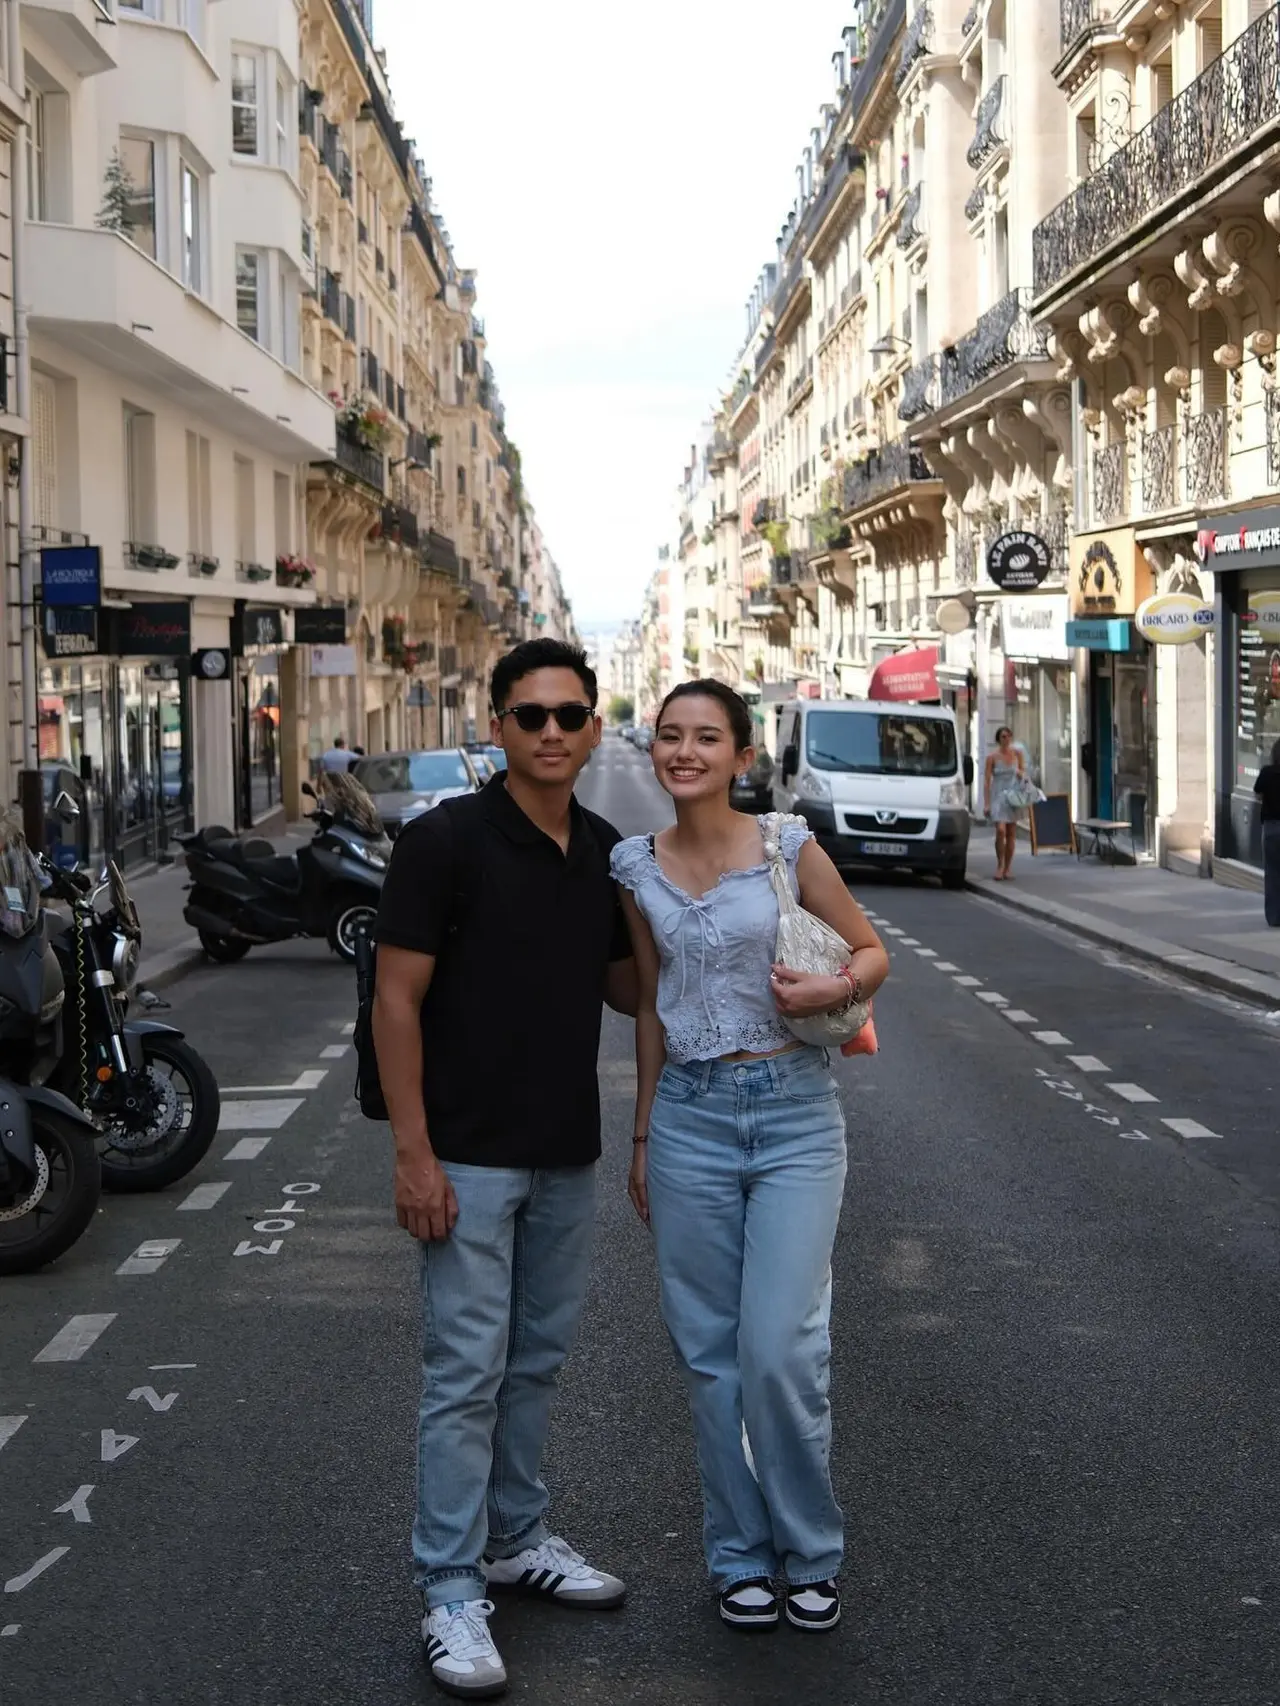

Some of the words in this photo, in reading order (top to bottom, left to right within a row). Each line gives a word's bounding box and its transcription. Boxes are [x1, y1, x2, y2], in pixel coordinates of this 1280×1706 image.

[996, 533, 1026, 553] PAIN
[991, 550, 1002, 568] LE
[1142, 613, 1189, 626] BRICARD
[233, 1182, 321, 1256] MOTO
